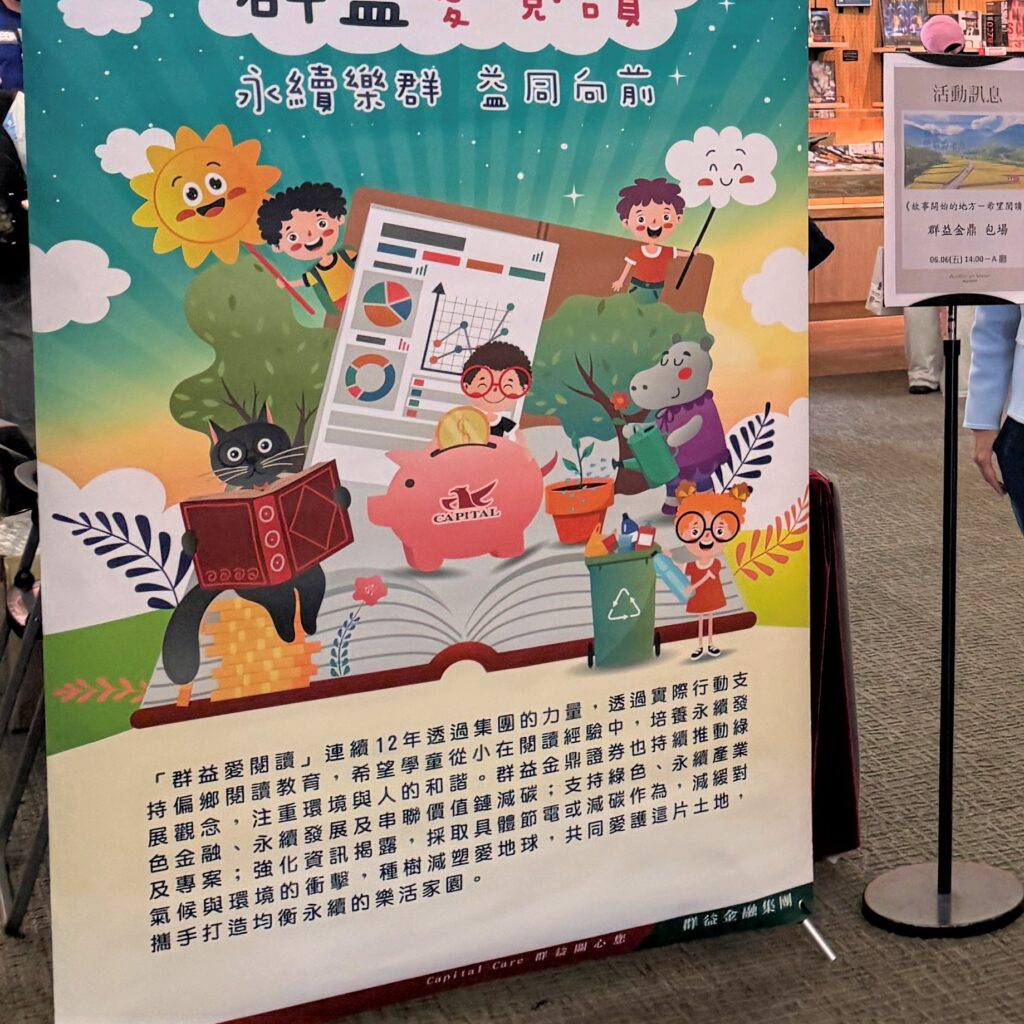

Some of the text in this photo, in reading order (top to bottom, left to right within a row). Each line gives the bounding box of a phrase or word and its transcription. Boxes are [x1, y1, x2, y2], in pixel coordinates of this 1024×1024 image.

[235, 63, 656, 115] 永續樂群 益同向前
[933, 84, 1003, 104] 活動訊息
[928, 223, 1008, 236] 群益金鼎 包場
[433, 508, 501, 523] CAPITAL
[683, 892, 793, 931] 群益金融集團
[426, 966, 482, 985] Capital
[492, 957, 525, 971] Care
